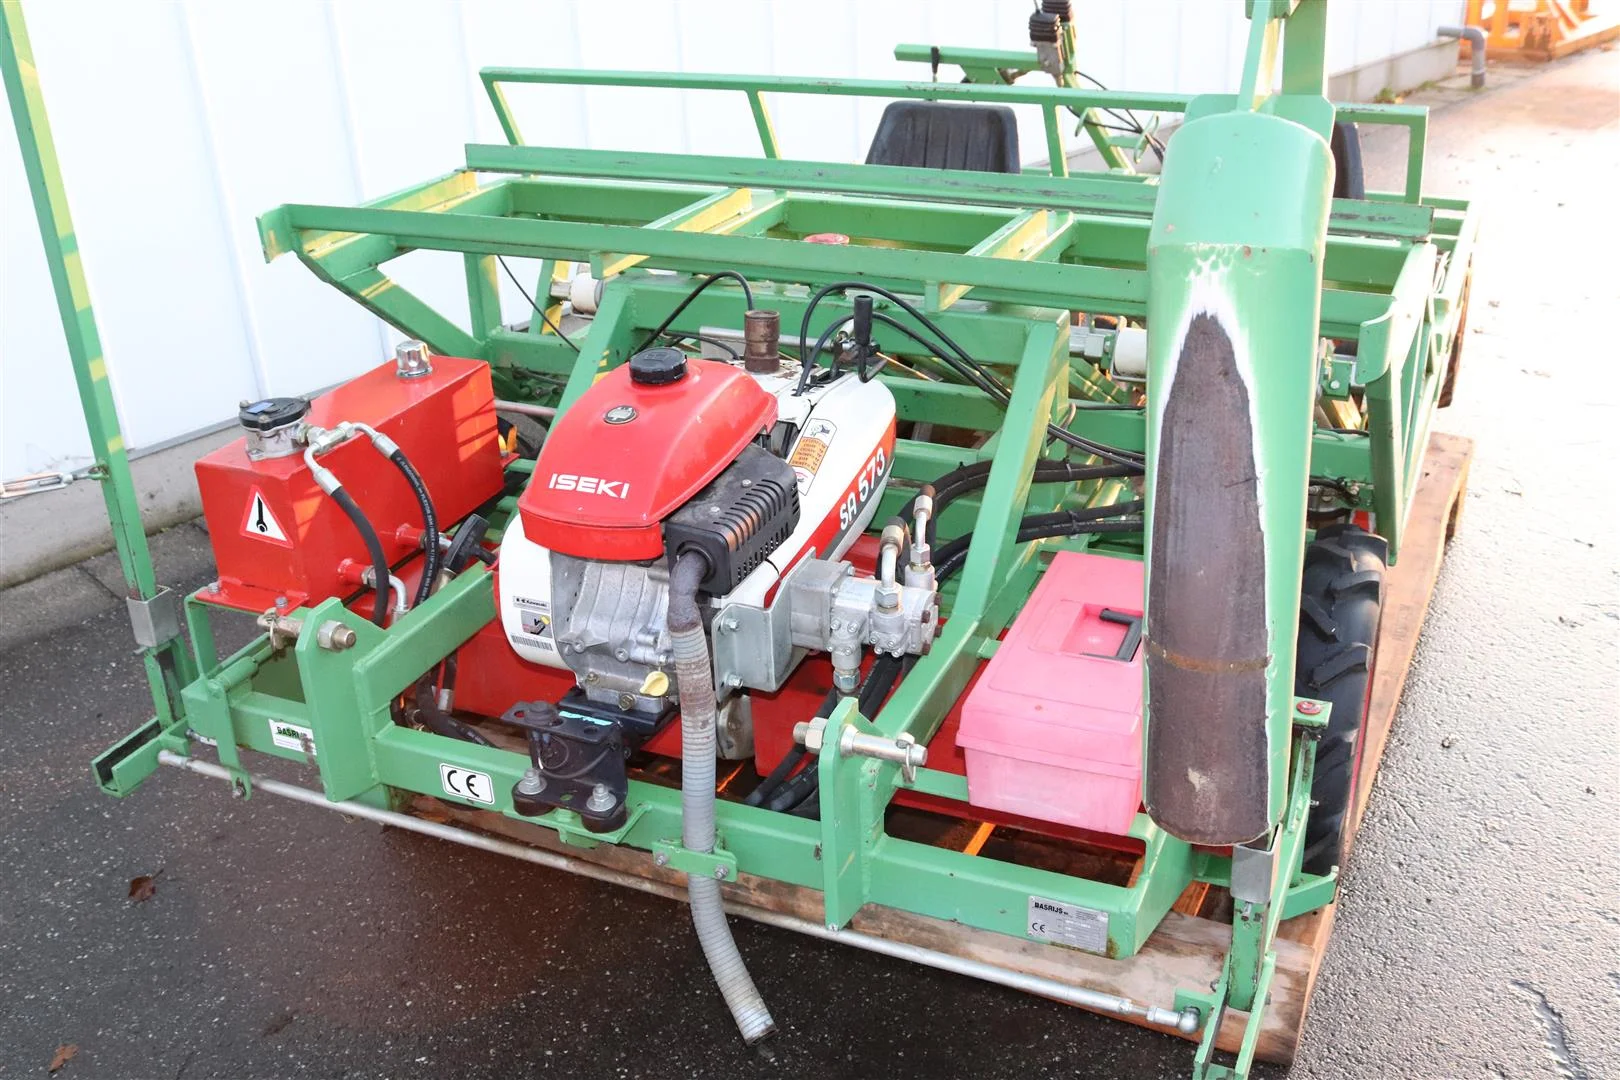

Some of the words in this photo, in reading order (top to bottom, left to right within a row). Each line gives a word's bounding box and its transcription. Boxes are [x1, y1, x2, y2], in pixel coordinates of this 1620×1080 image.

[549, 473, 630, 499] ISEKI
[840, 491, 857, 530] SA
[858, 447, 885, 502] 573
[447, 769, 480, 798] CE
[1034, 902, 1063, 914] BASRIJS
[1032, 922, 1046, 934] CE
